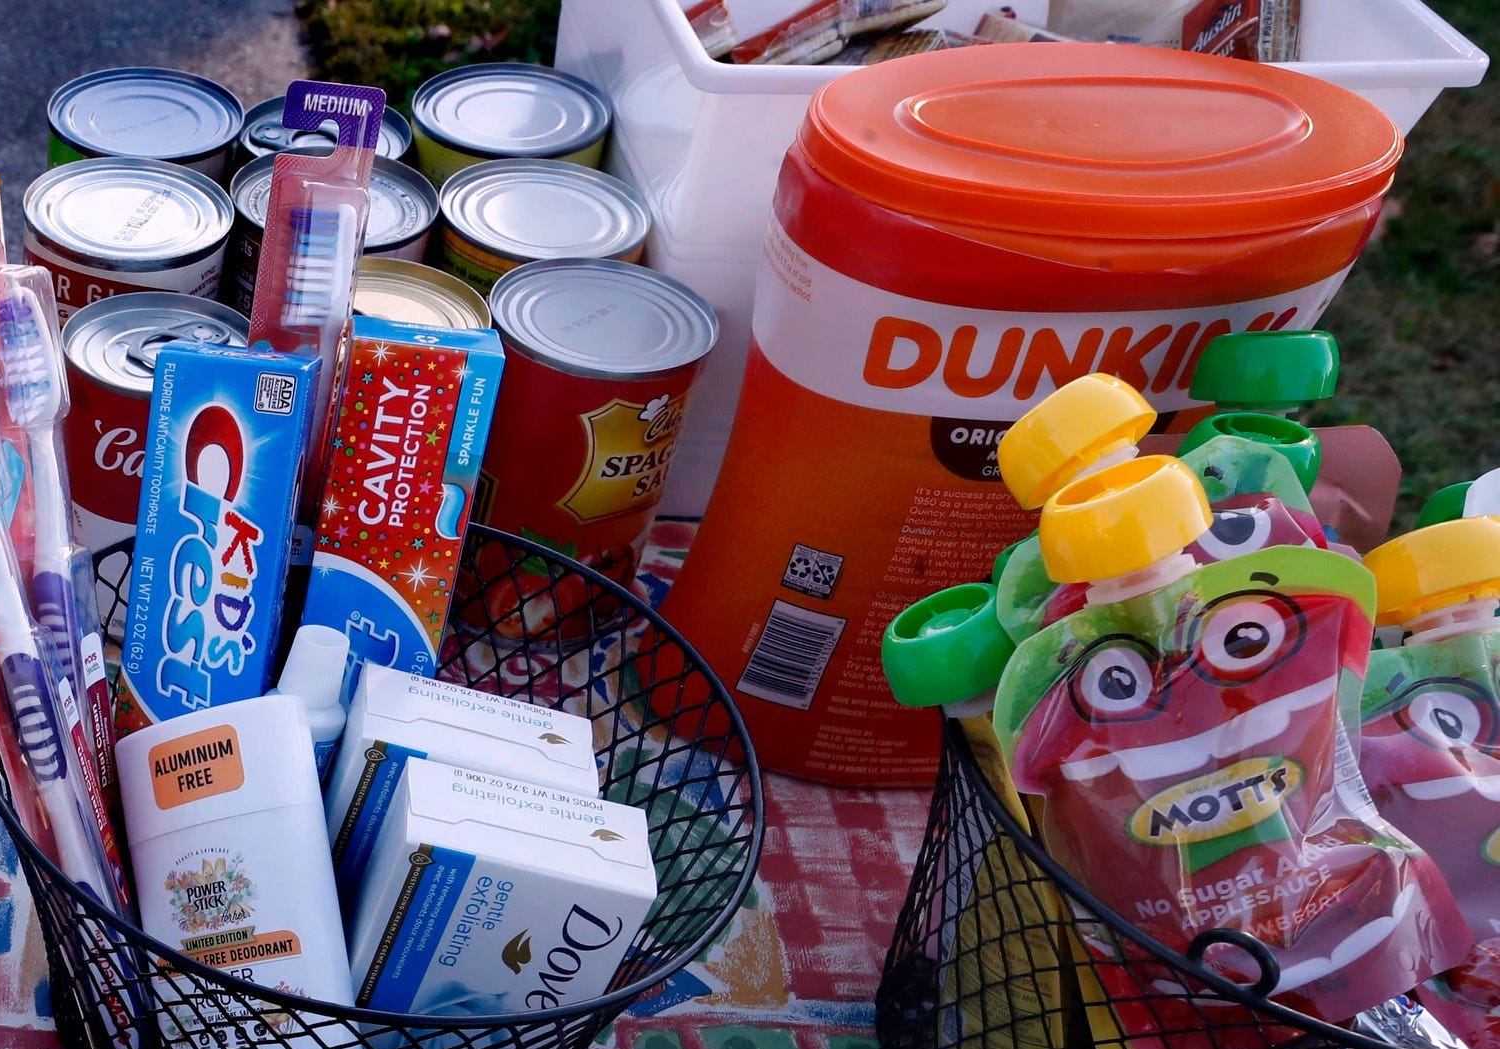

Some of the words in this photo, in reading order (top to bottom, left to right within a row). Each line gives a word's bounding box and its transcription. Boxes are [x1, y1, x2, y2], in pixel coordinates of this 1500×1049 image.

[305, 93, 368, 117] MEDIUM
[160, 362, 176, 412] FLUORIDE
[280, 380, 293, 409] ADA
[458, 408, 480, 465] SPARKLE
[472, 377, 487, 405] FUN
[153, 414, 170, 472] ANTICAVITY
[357, 376, 410, 525] CAVITY
[388, 384, 432, 527] PROTECTION
[145, 475, 162, 534] TOOTHPASTE
[914, 497, 937, 507] 1950
[943, 491, 983, 499] success
[910, 506, 946, 518] Quincy,
[899, 536, 933, 545] donuts
[902, 525, 938, 536] Dunkin'
[157, 401, 244, 709] Crest
[895, 545, 927, 555] coffee
[140, 556, 155, 581] NET
[138, 583, 152, 603] WT
[207, 511, 263, 675] KID'S
[408, 686, 496, 713] exfoliating
[501, 710, 553, 730] gentle
[155, 739, 234, 778] ALUMINUM
[177, 768, 213, 792] FREE
[452, 783, 544, 812] exfoliating
[573, 798, 604, 811] POIDS
[550, 805, 605, 826] gentle
[186, 881, 227, 903] POWER
[399, 867, 421, 910] MOISTURIZING
[1135, 899, 1171, 919] No
[1177, 868, 1265, 908] Sugar
[1182, 864, 1333, 931] APPLESAUCE
[194, 896, 225, 912] STICK
[481, 880, 514, 932] gentle
[438, 875, 493, 967] exfoliating
[185, 936, 214, 951] LIMITED
[216, 930, 248, 945] EDITION
[231, 939, 293, 962] DEODORANT
[525, 904, 623, 1010] Dove
